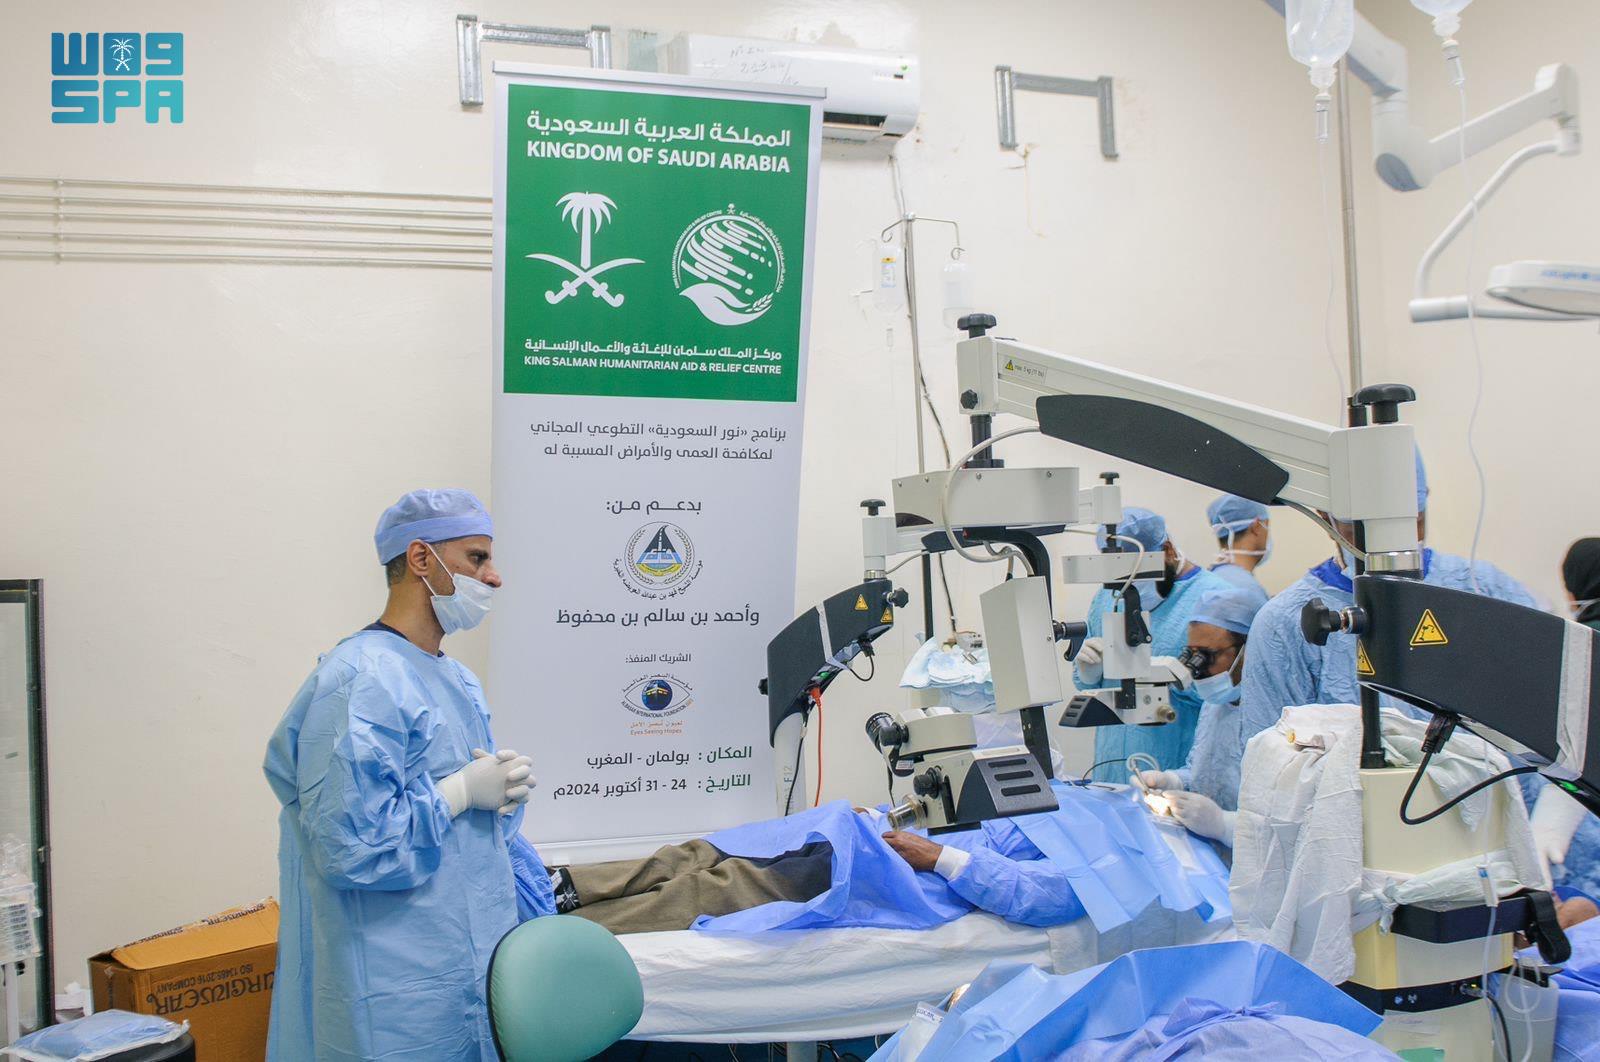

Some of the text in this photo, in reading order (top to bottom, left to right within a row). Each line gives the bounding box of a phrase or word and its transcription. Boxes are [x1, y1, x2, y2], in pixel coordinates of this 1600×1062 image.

[526, 110, 791, 148] المملكة العربية السعودية
[527, 140, 791, 173] KINGDOM OF SAUDI ARABIA
[524, 338, 782, 362] مركز الملك سلمان للإغاثة والأعمال الإنسانية
[524, 355, 782, 375] KING SALMAN HUMANITARIAN AID & RELIEF CENTRE
[530, 420, 583, 436] المجاني
[586, 422, 644, 438] التطوعي
[750, 427, 787, 443] برنامج
[544, 441, 773, 461] لمكافحة العمى والأمراض المسببة له
[646, 500, 702, 516] بدعم
[556, 603, 760, 628] وأحمد بن سالم بن محفوظ
[625, 652, 692, 665] الشريك المنفذ:
[586, 752, 633, 770] المغرب
[645, 750, 690, 767] بولمان
[706, 745, 752, 764] المكان
[602, 776, 642, 798] أكتوبر
[645, 779, 658, 792] 31
[670, 778, 687, 791] 24
[705, 773, 751, 794] التاريخ
[240, 964, 253, 974] ISO
[155, 976, 195, 992] COMPANY
